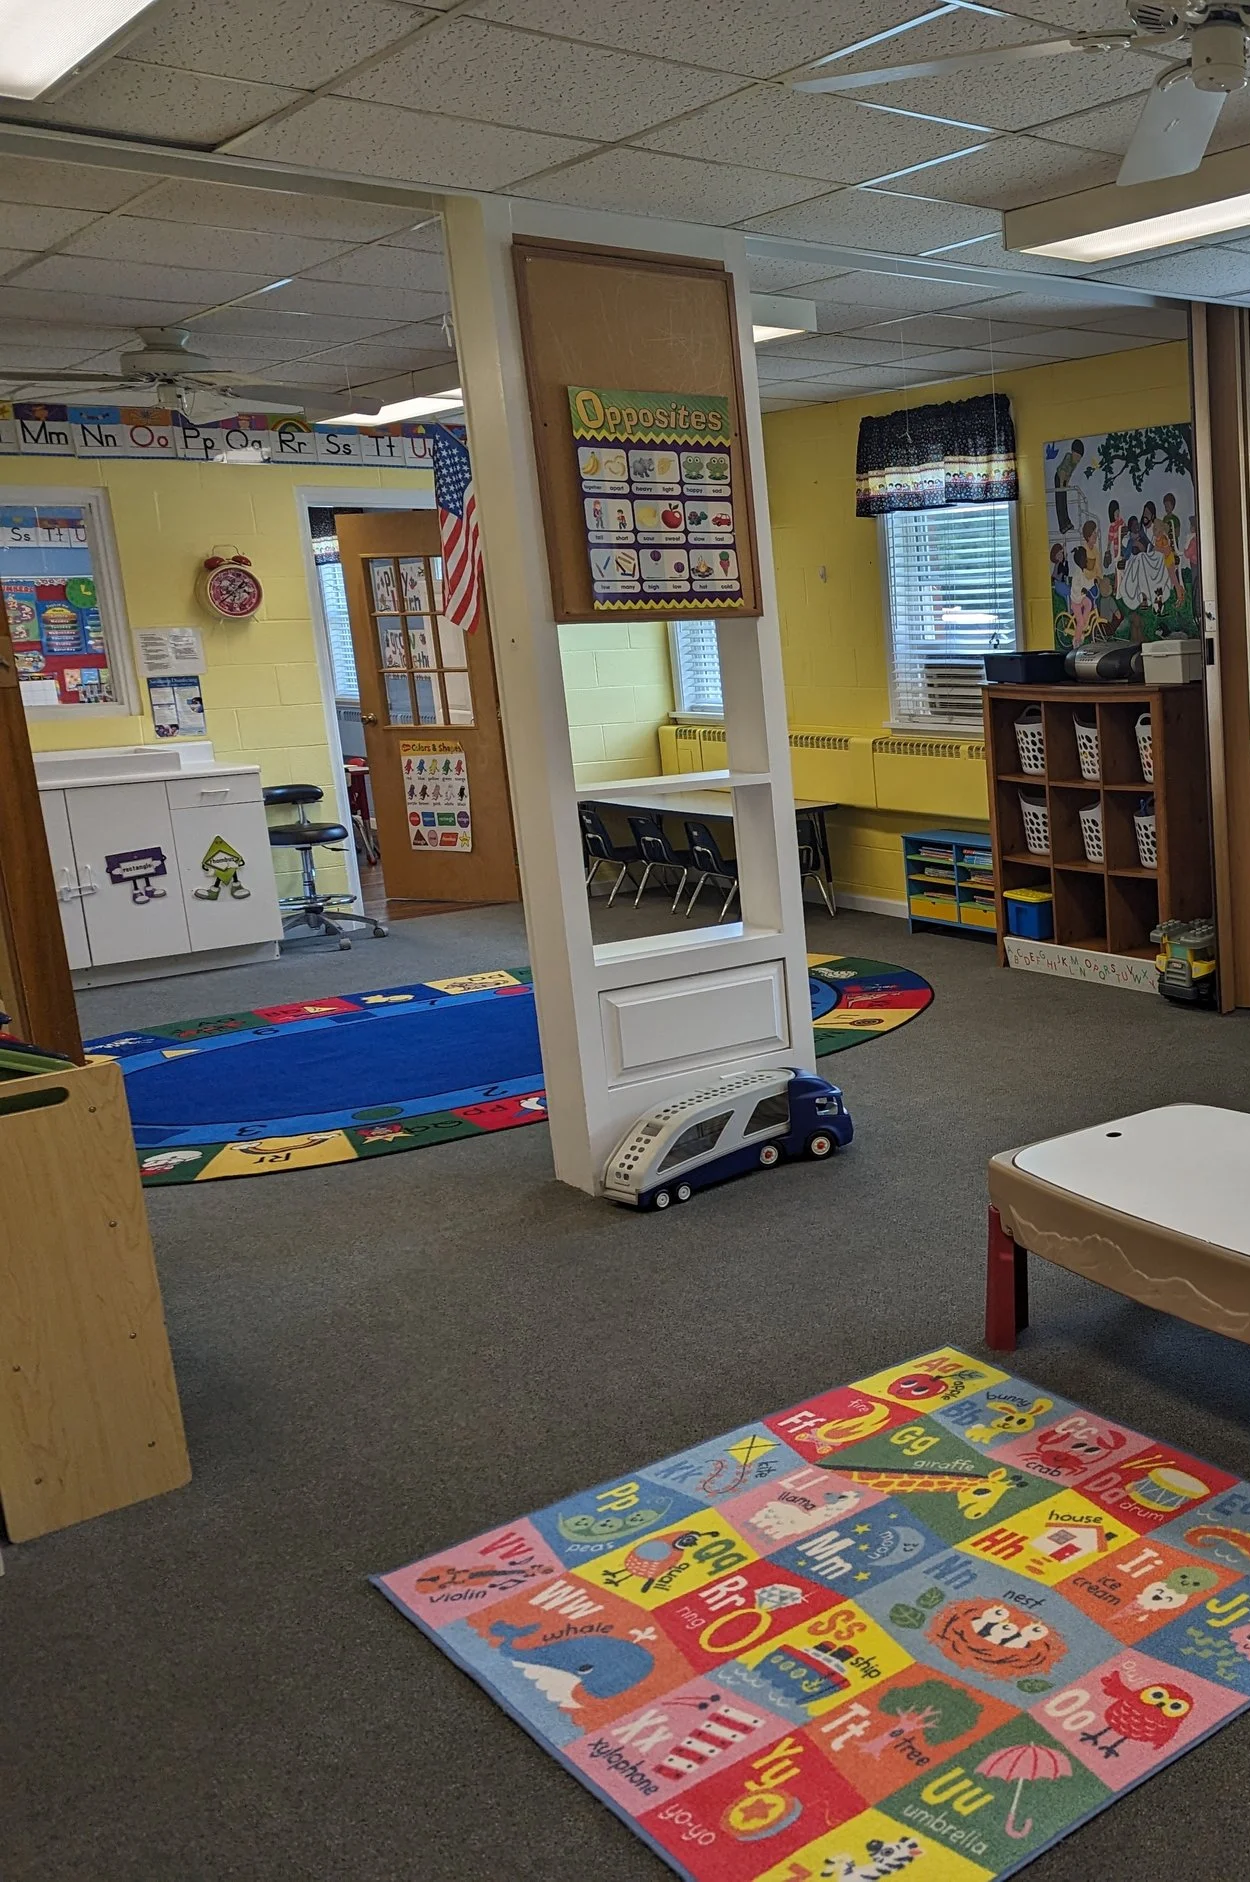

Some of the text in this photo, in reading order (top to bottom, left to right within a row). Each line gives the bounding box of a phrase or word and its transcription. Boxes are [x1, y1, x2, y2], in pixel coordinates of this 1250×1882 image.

[575, 390, 723, 435] Opposites
[20, 419, 69, 445] Mm
[81, 424, 117, 447] Nn
[130, 425, 169, 448] Oo
[182, 427, 215, 459] Pp
[278, 431, 307, 454] Rr
[326, 434, 352, 455] Ss
[368, 435, 396, 457] Tt
[635, 485, 653, 493] heavy
[122, 862, 153, 873] rectangle
[914, 1356, 962, 1373] Aa
[941, 1381, 965, 1400] apple
[986, 1391, 1031, 1407] bunny
[847, 1399, 870, 1412] fire
[777, 1410, 827, 1434] Ff
[1053, 1416, 1098, 1440] Cc
[889, 1426, 940, 1456] Gg
[754, 1460, 778, 1479] kite
[912, 1458, 975, 1472] giraffe
[1024, 1461, 1063, 1477] crab
[596, 1481, 640, 1512] Pp
[777, 1491, 817, 1510] llama
[1119, 1500, 1166, 1522] drum
[1048, 1510, 1104, 1524] house
[478, 1532, 534, 1561] Vv
[565, 1540, 616, 1553] peas
[692, 1538, 748, 1576] Qq
[796, 1530, 856, 1580] Mm
[867, 1530, 894, 1560] moon
[970, 1527, 1030, 1561] Hh
[653, 1562, 690, 1591] quail
[922, 1553, 978, 1591] Nn
[1115, 1547, 1164, 1579] Ii
[429, 1588, 488, 1604] violin
[698, 1575, 749, 1612] Rr
[1072, 1576, 1122, 1606] cream
[1098, 1575, 1122, 1591] ice
[528, 1579, 605, 1621] Ww
[1003, 1589, 1047, 1609] nest
[542, 1622, 615, 1642] whale
[676, 1605, 707, 1630] ring
[807, 1609, 867, 1641] Ss
[850, 1655, 882, 1680] ship
[1044, 1688, 1097, 1732] Oo
[611, 1708, 674, 1753] Xx
[821, 1702, 872, 1752] Tt
[744, 1737, 804, 1791] Yy
[895, 1736, 930, 1767] tree
[588, 1737, 660, 1796] xylophone
[920, 1767, 995, 1817] Uu
[657, 1803, 717, 1846] yo-yo
[902, 1803, 989, 1857] umbrella
